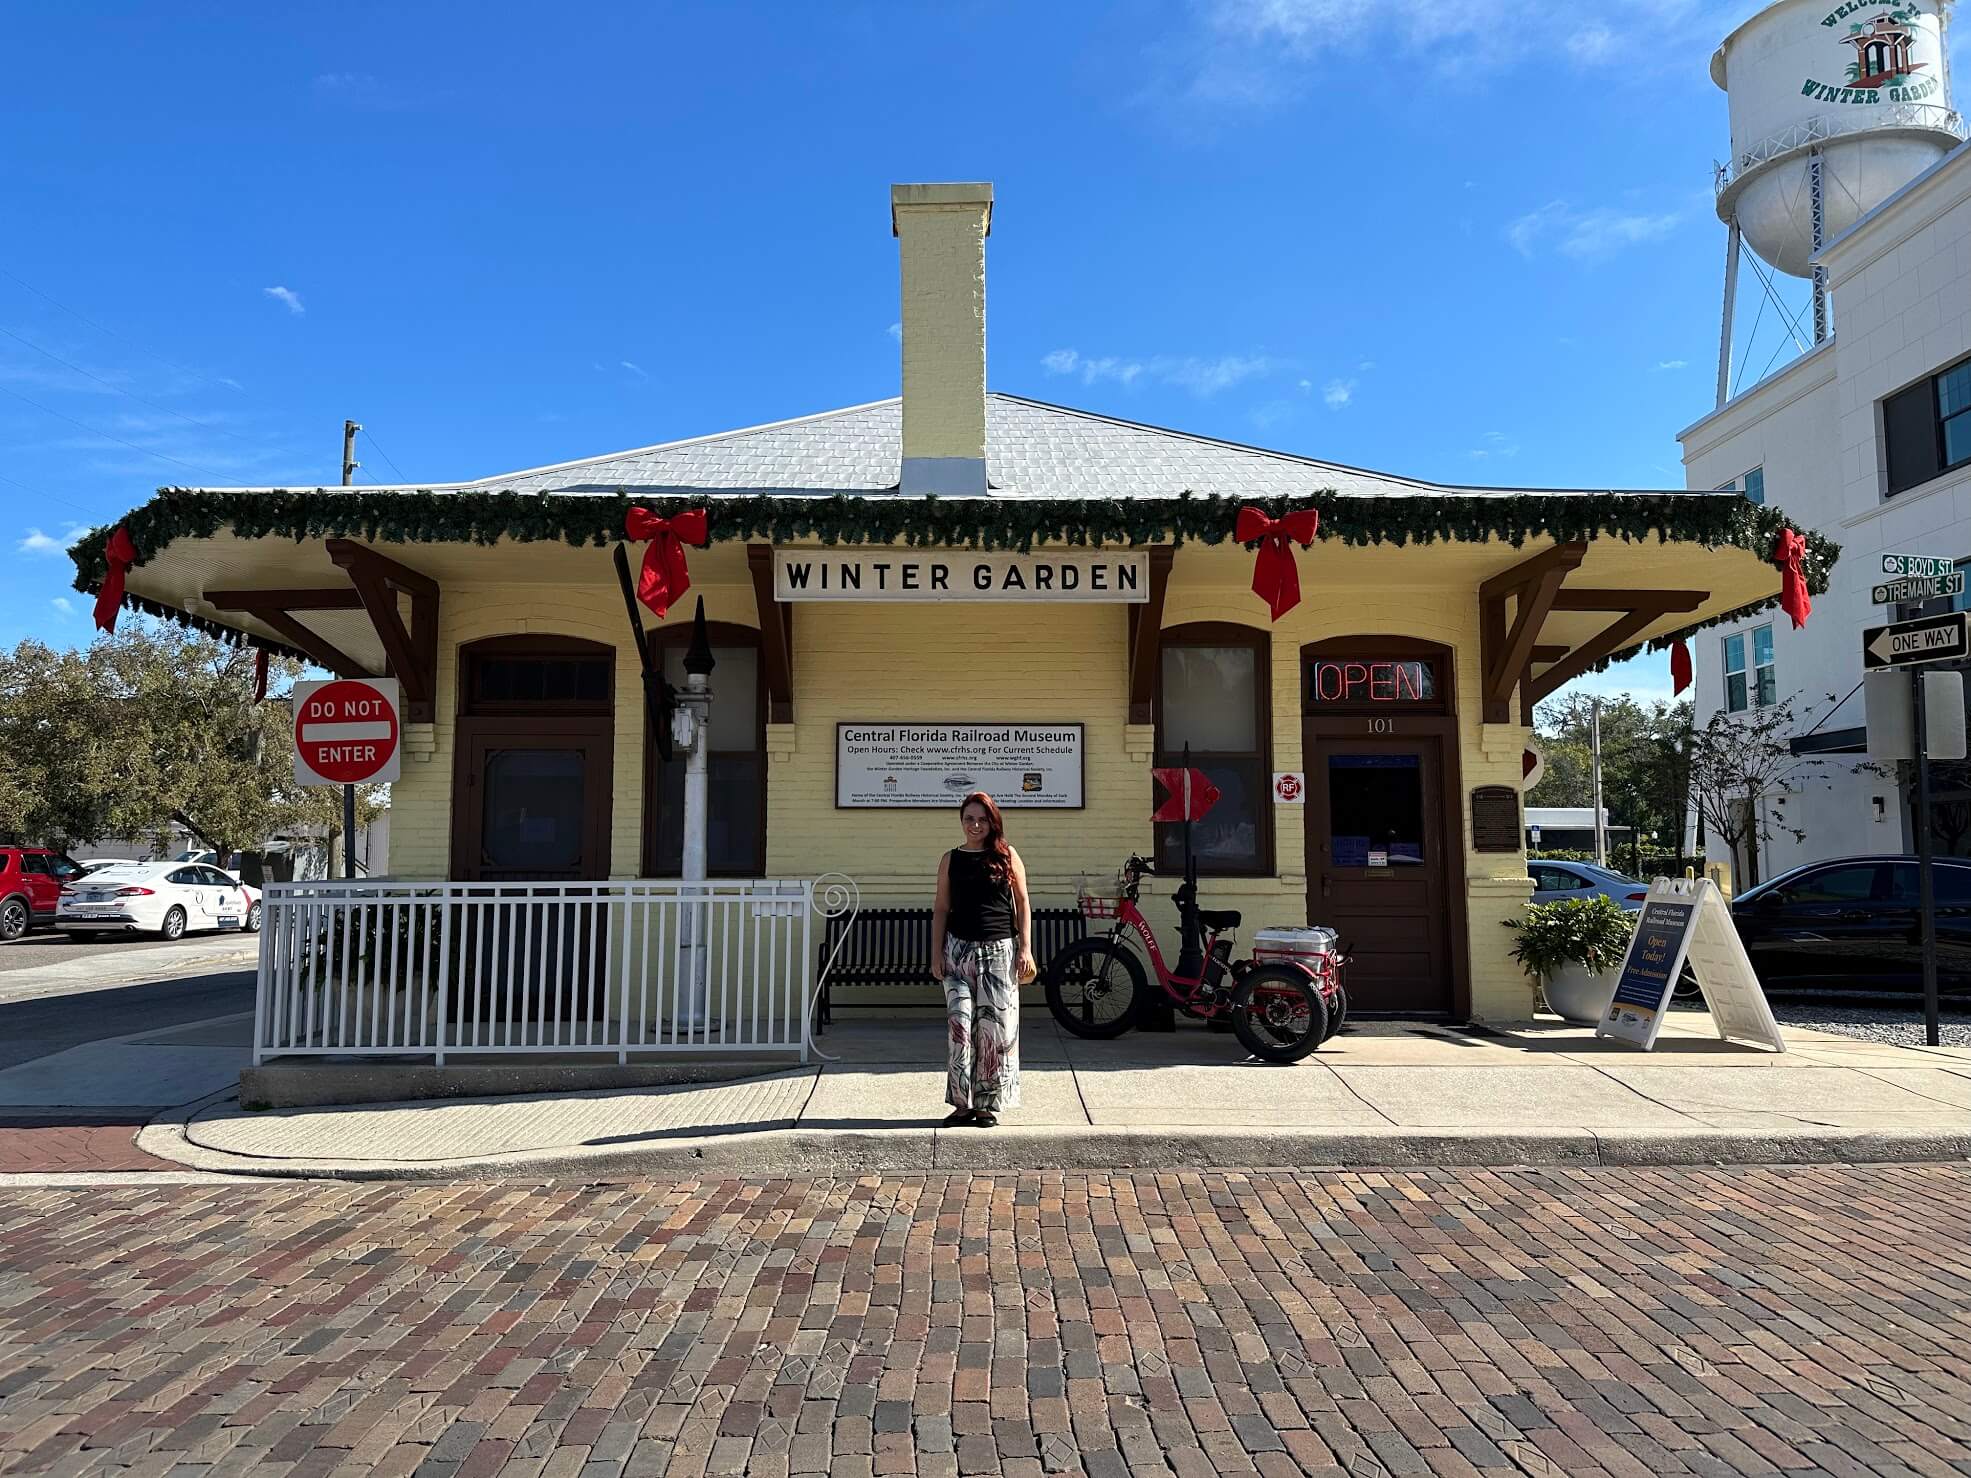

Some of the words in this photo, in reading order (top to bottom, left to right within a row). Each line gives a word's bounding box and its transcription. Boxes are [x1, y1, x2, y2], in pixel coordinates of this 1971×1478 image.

[1801, 79, 1880, 104] WINTER
[1889, 75, 1938, 102] GARDEN
[1897, 557, 1904, 574] S
[1908, 558, 1934, 575] BOYD
[1938, 560, 1950, 575] ST
[787, 563, 950, 589] WINTER
[973, 564, 1137, 589] GARDEN
[1887, 578, 1941, 601] TREMAINE
[1946, 573, 1960, 593] ST
[1892, 633, 1919, 652] ONE
[1924, 627, 1954, 647] WAY
[1319, 664, 1420, 700] OPEN
[311, 702, 335, 717] DO
[345, 700, 382, 716] NOT
[1368, 719, 1393, 733] 101
[845, 729, 894, 742] Central
[899, 729, 947, 742] Florida
[952, 729, 1010, 742] Railroad
[1014, 730, 1075, 742] Museum
[319, 746, 376, 763] ENTER
[847, 746, 869, 754] Open
[872, 746, 898, 754] Hours:
[900, 746, 924, 754] Check
[926, 746, 986, 755] www.cfrhs.org
[1003, 746, 1034, 754] Current
[1036, 746, 1073, 754] Schedule
[1282, 783, 1295, 792] RF
[1651, 908, 1668, 916] Central
[1668, 909, 1685, 917] Florida
[1645, 917, 1665, 925] Railroad
[1648, 936, 1666, 948] Open
[1642, 950, 1665, 964] Today!
